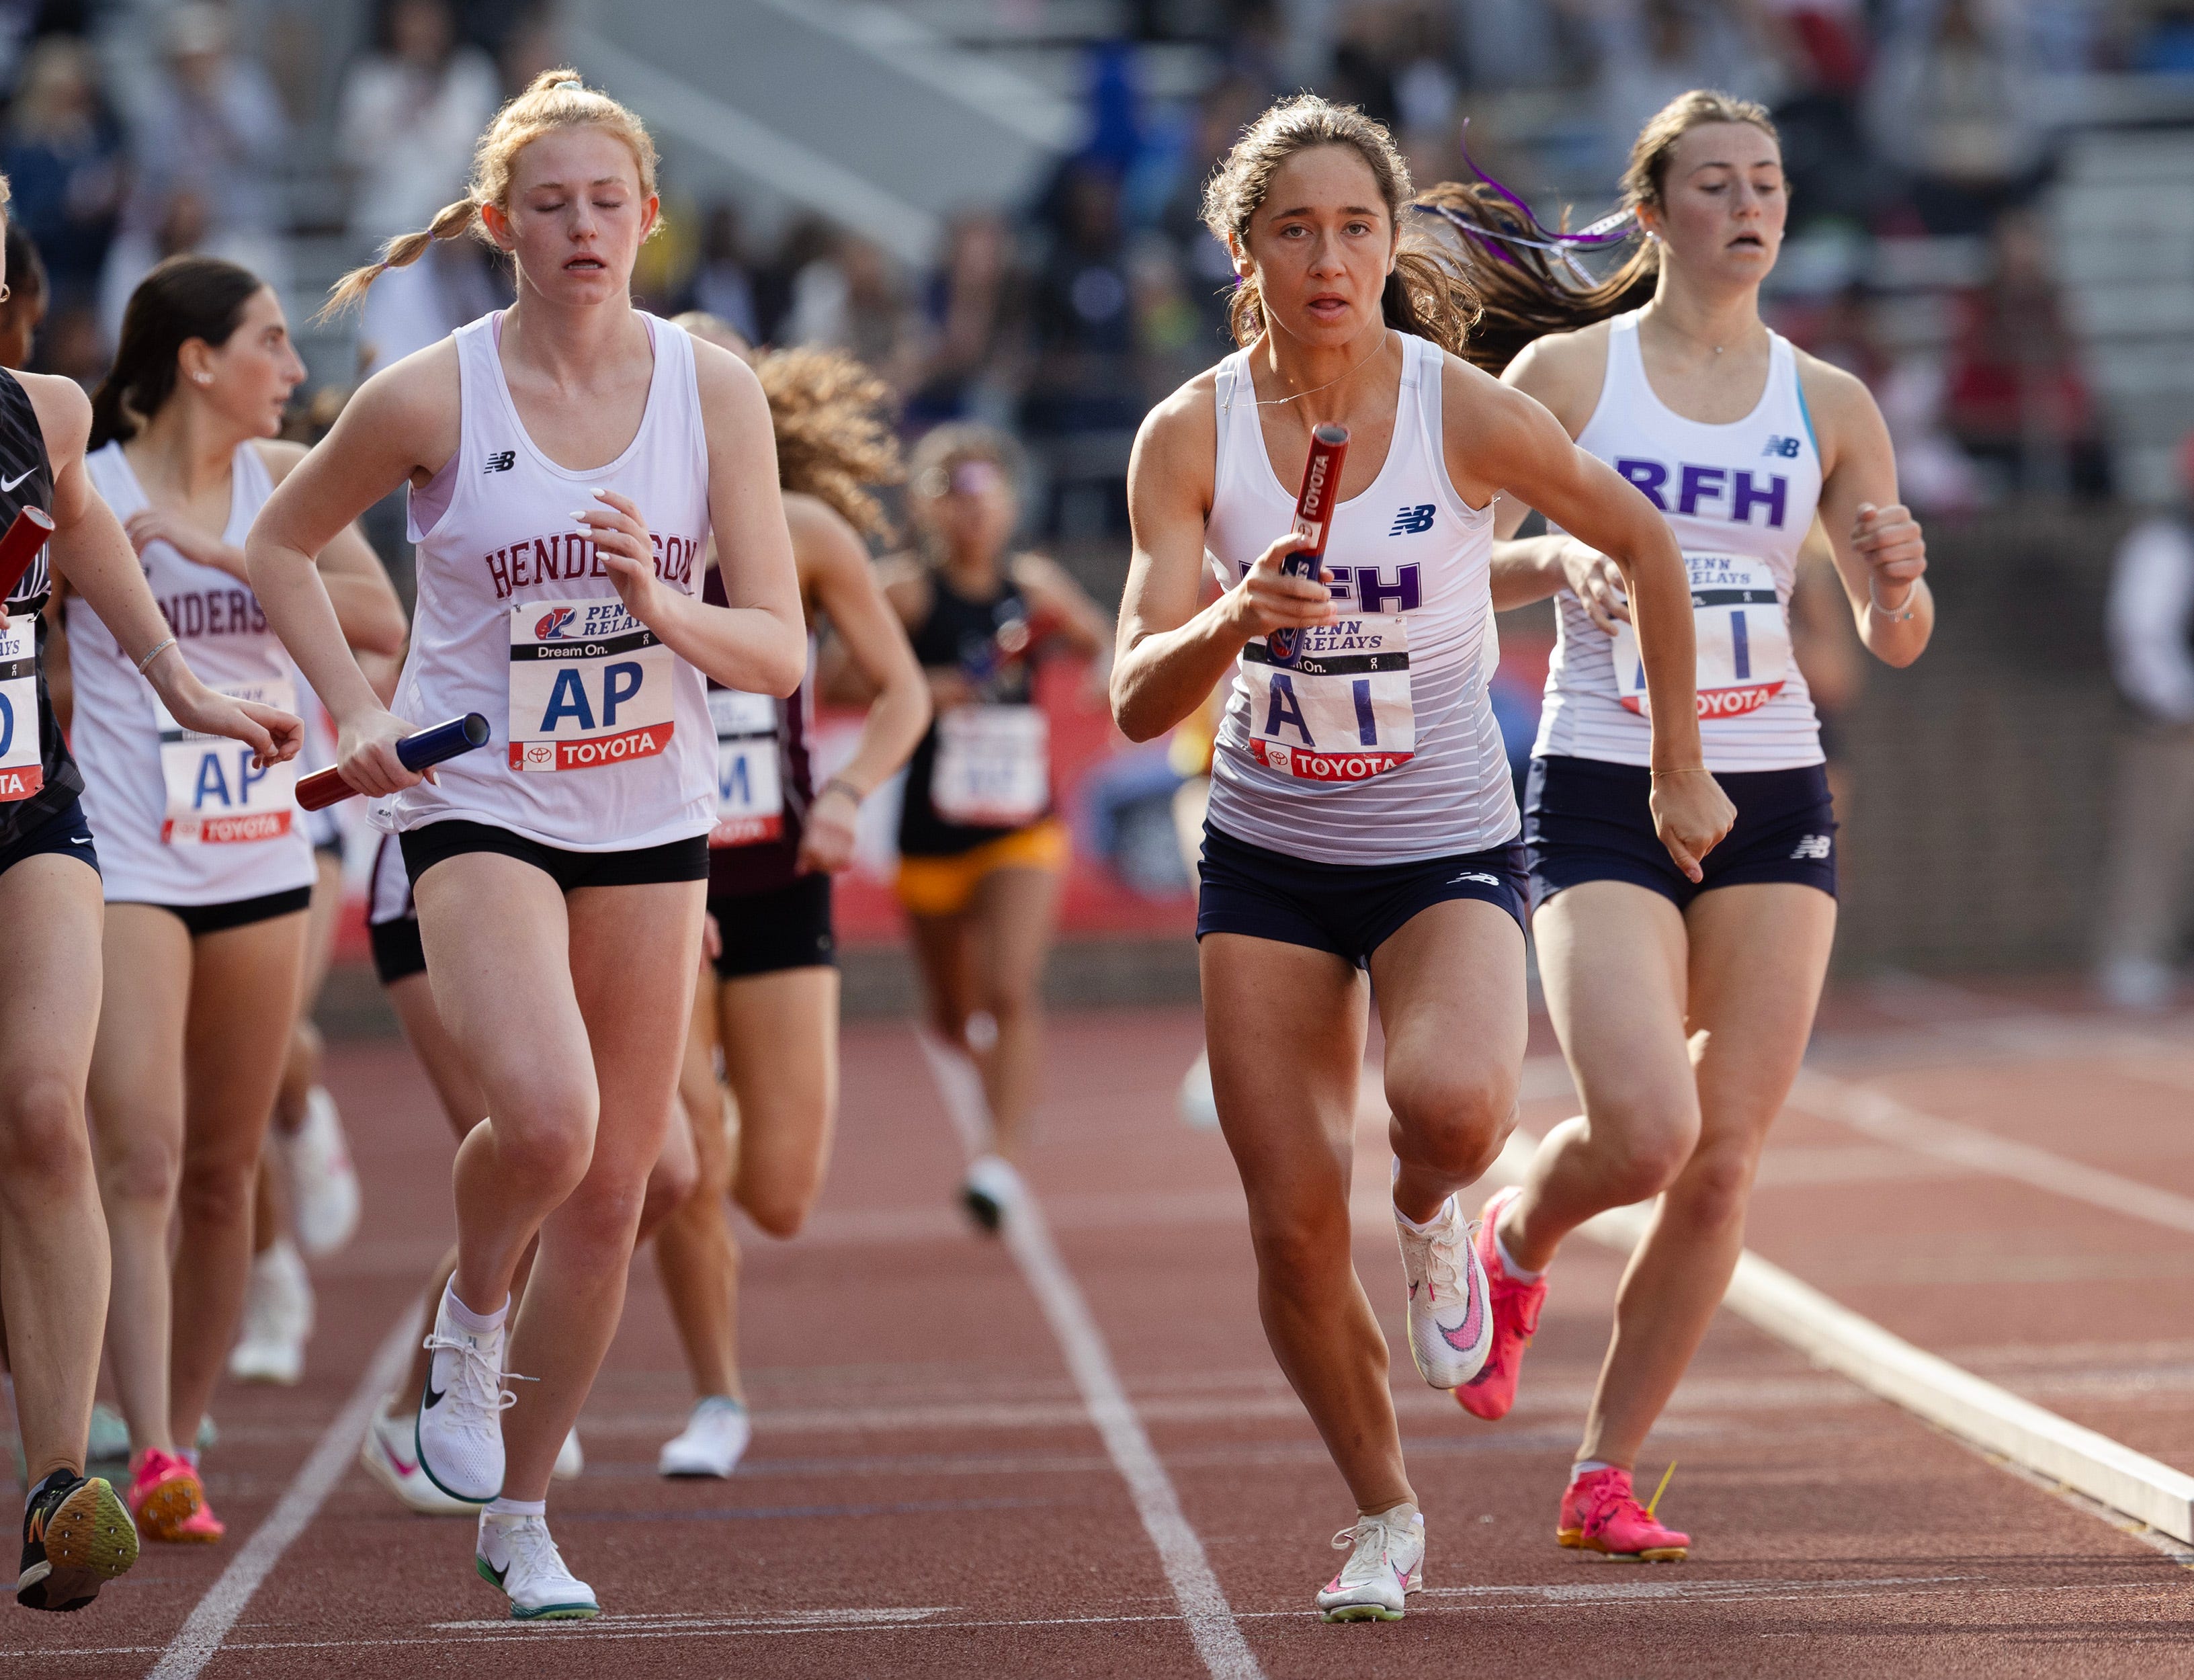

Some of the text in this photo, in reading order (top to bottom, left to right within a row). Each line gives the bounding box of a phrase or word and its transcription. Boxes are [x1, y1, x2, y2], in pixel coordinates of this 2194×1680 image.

[1303, 455, 1329, 515] TOYOTA
[1613, 456, 1788, 531] RFH
[484, 530, 699, 599] HENDESON
[1690, 571, 1750, 585] ELAYS
[586, 603, 629, 620] PEN
[538, 644, 608, 657] Dream On.
[1304, 661, 1326, 673] On.
[540, 661, 643, 732] AP
[563, 732, 656, 764] TOYOTA
[194, 750, 268, 810] AP
